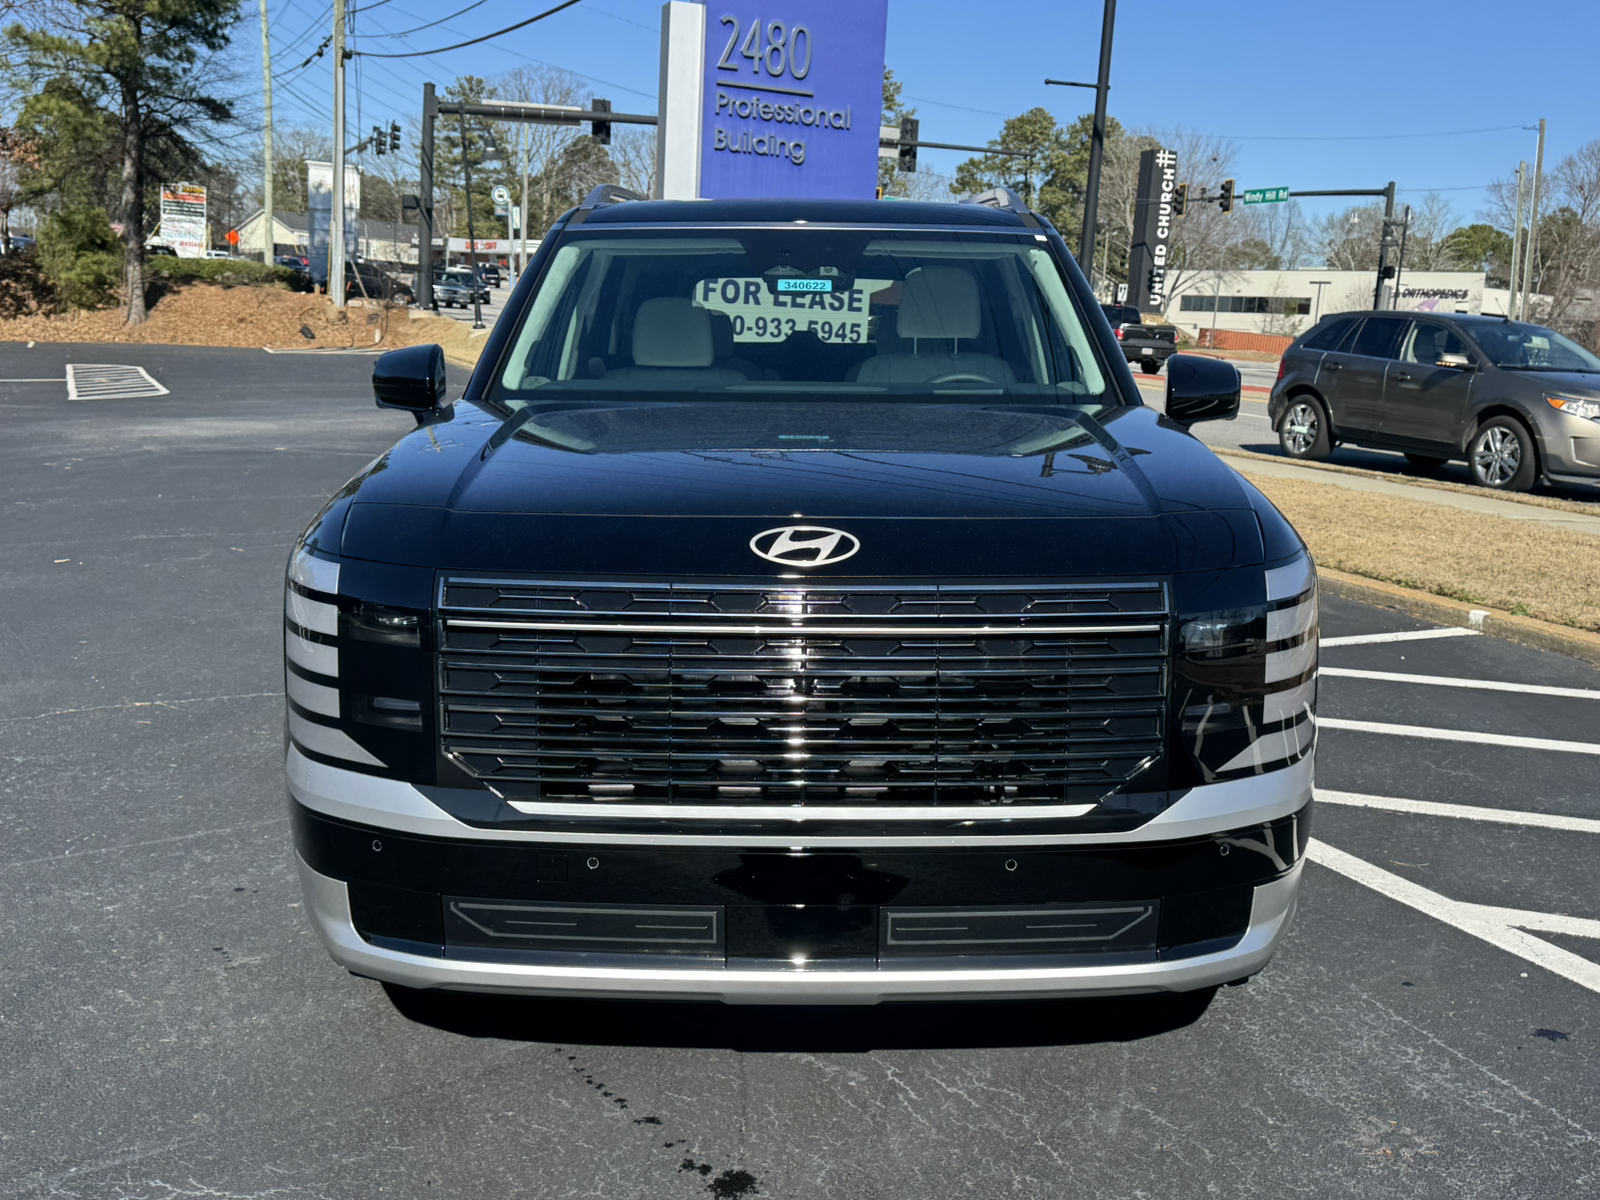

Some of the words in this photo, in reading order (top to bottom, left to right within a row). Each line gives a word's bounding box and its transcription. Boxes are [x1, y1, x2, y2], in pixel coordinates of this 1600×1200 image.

[717, 14, 812, 80] 2480
[715, 91, 851, 130] Professional
[714, 127, 806, 166] Building
[1157, 169, 1175, 239] CHURCH
[1245, 191, 1263, 203] Windy
[1265, 190, 1277, 201] Hill
[1278, 189, 1288, 200] Rd
[784, 281, 826, 290] 340622
[1150, 244, 1167, 305] UNITED
[702, 278, 761, 305] FOR
[1402, 288, 1469, 300] ORTHOPEDICS
[732, 315, 862, 343] 0-9335945
